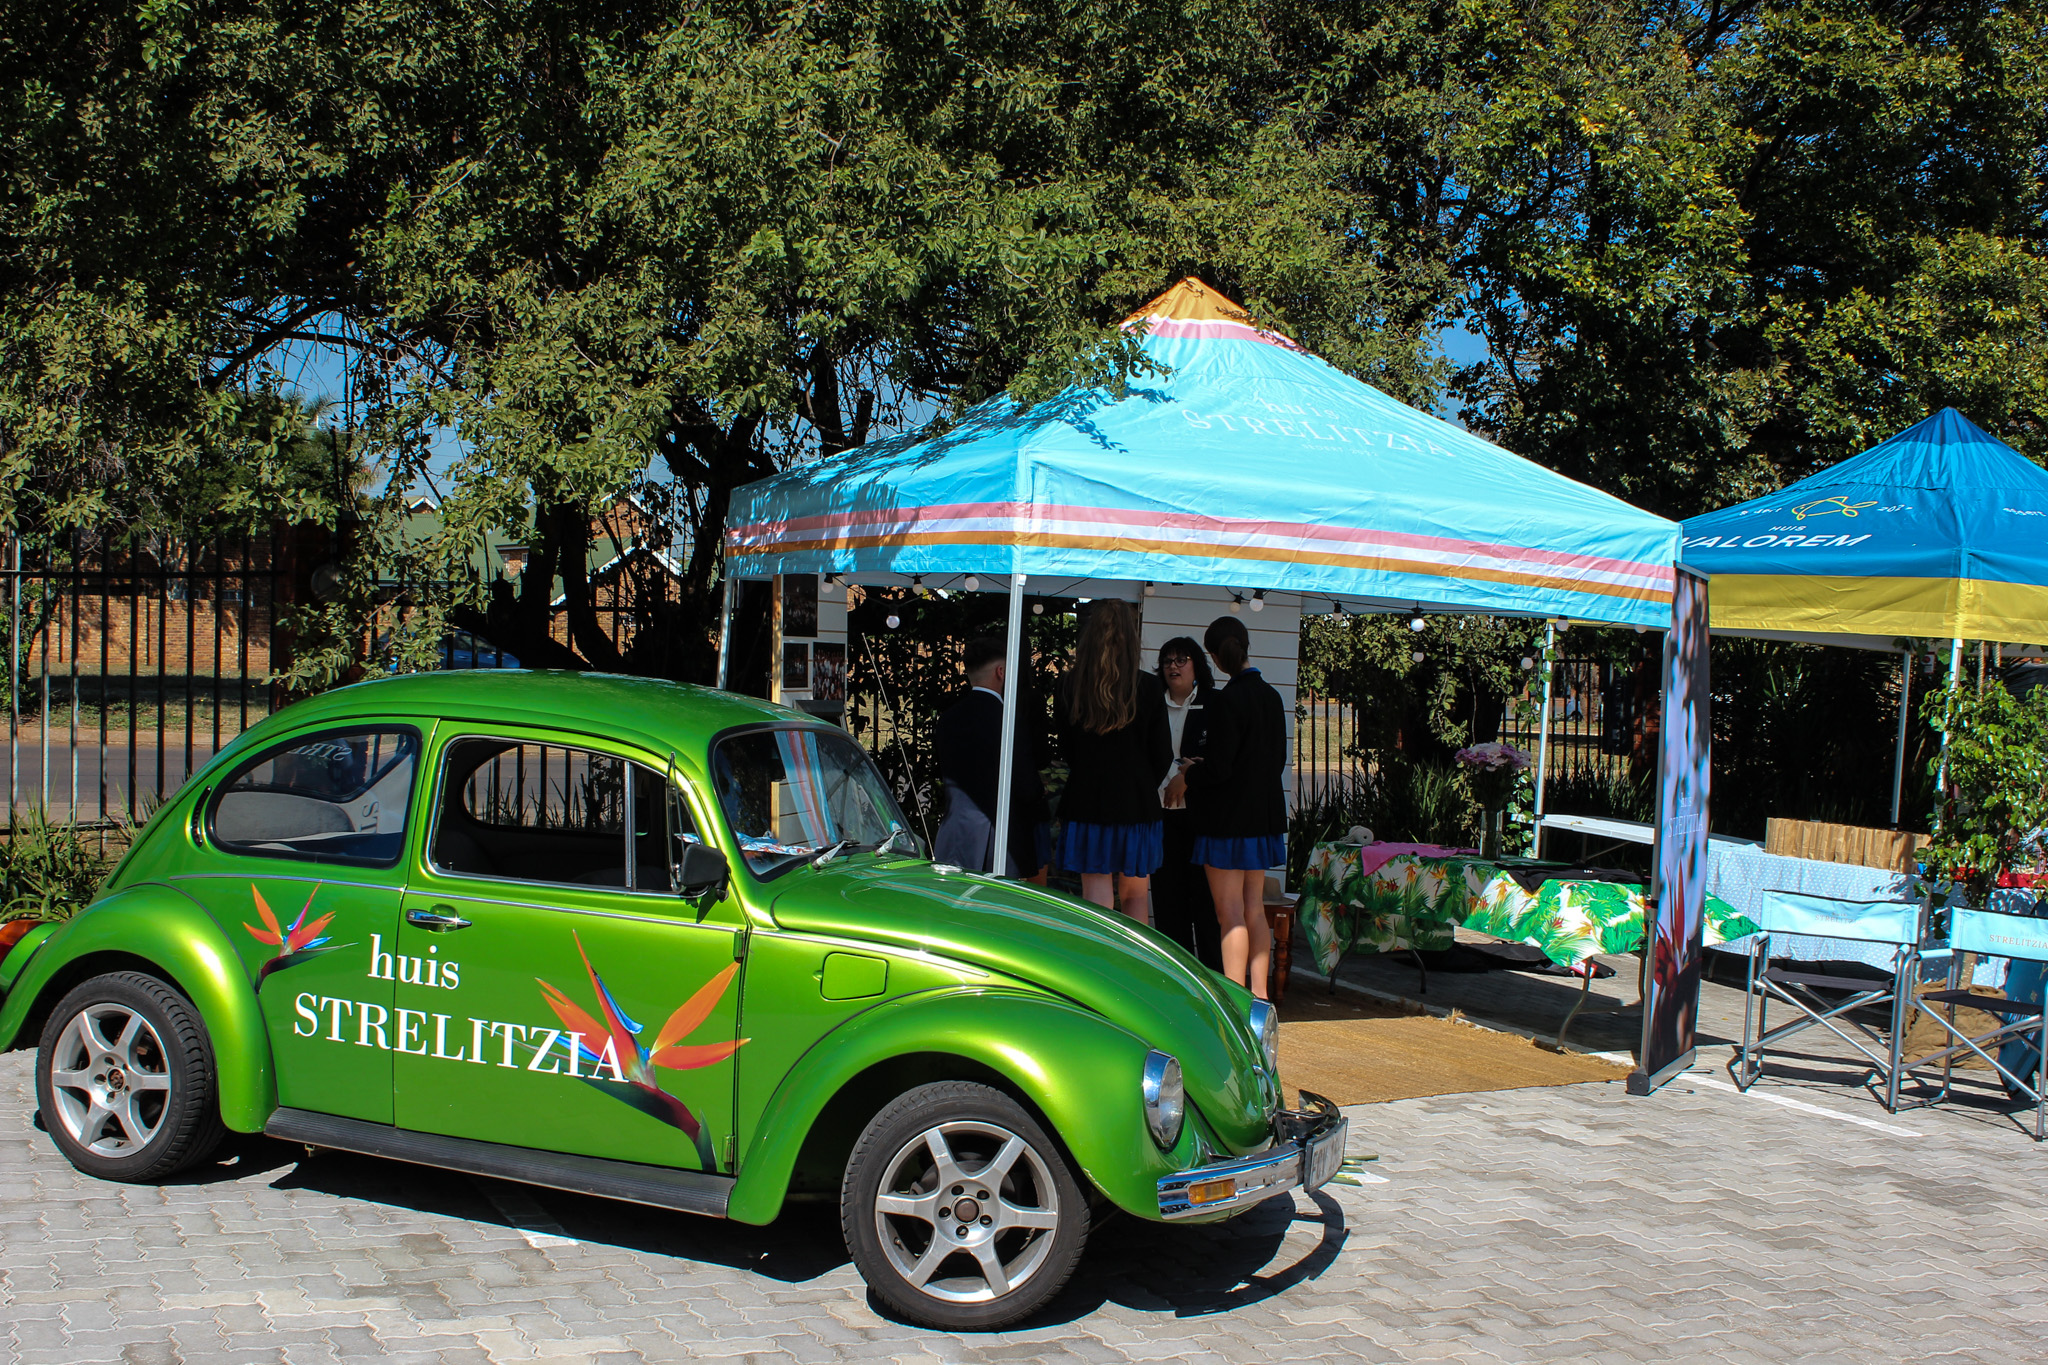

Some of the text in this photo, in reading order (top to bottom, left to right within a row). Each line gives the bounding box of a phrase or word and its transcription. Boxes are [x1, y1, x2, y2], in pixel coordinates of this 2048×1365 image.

[1181, 409, 1456, 458] STRELITZIA
[367, 933, 460, 990] huis
[1989, 934, 2048, 949] STRELITZIA
[293, 992, 630, 1083] STRELITZIA
